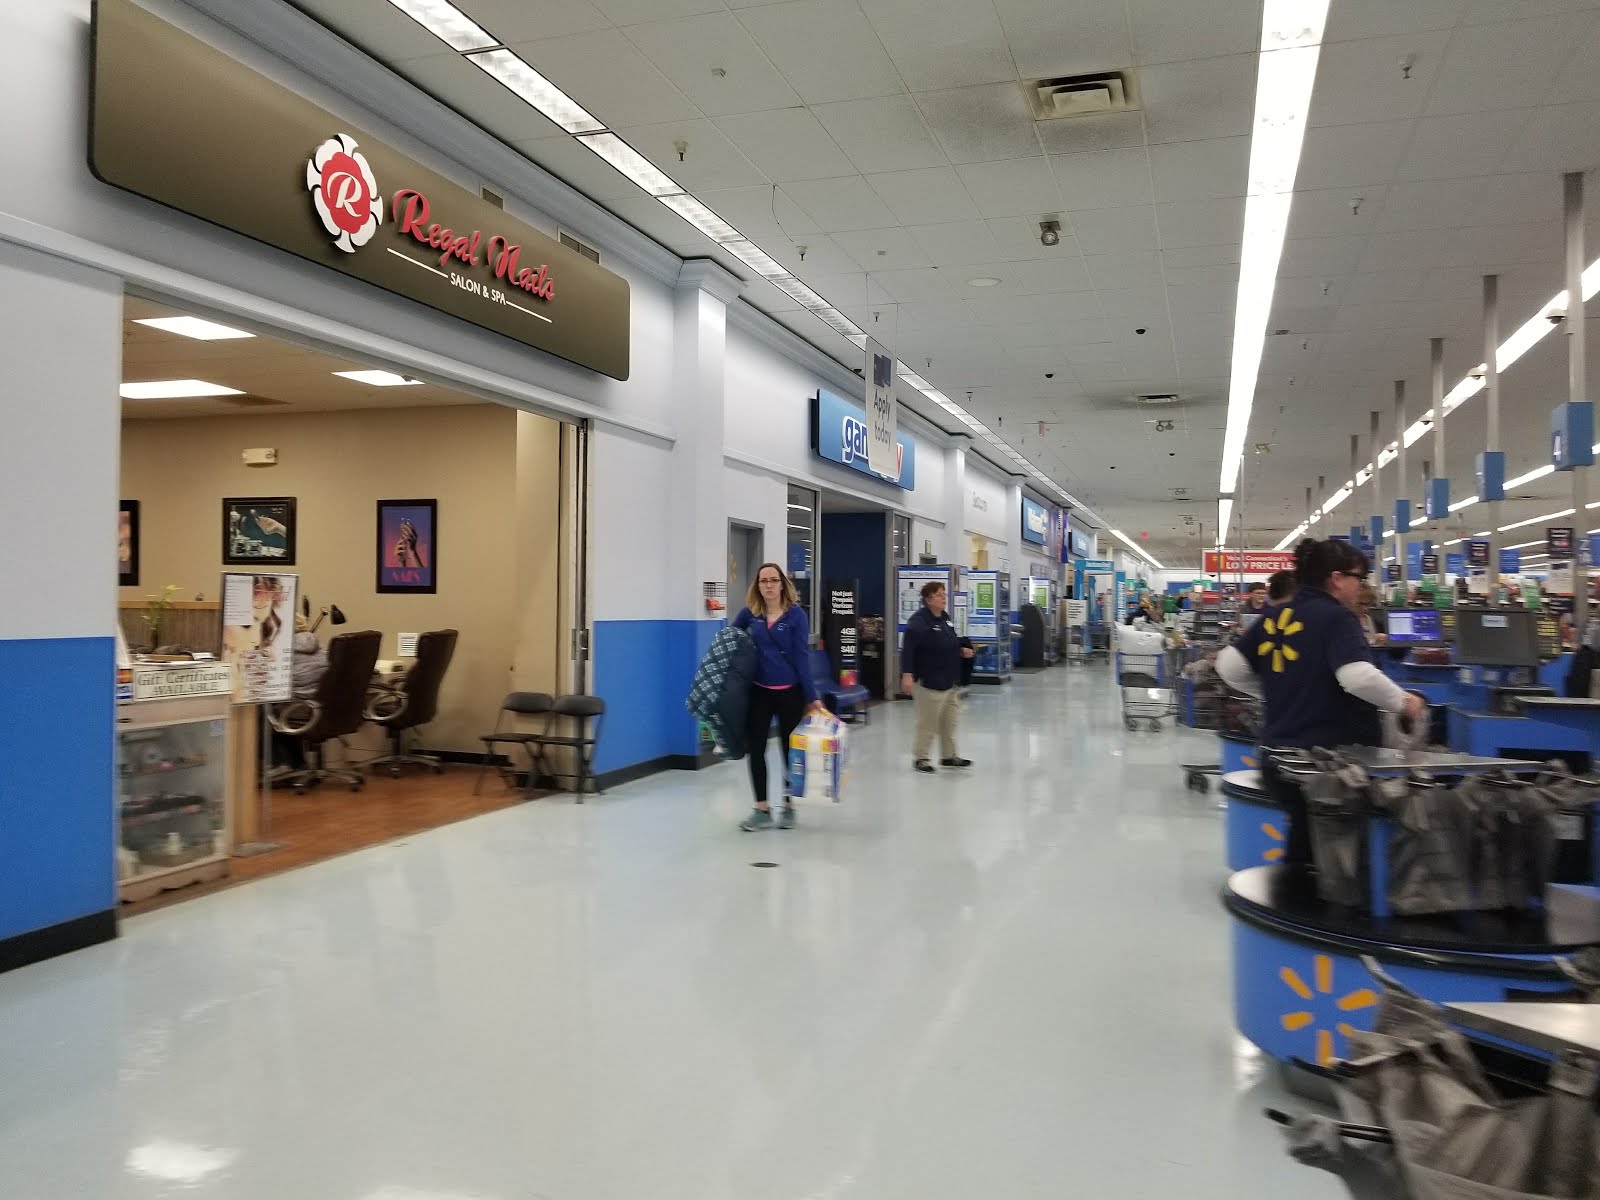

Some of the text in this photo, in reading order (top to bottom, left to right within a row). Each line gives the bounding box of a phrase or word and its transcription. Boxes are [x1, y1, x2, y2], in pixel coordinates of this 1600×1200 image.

[326, 171, 362, 218] R
[392, 189, 555, 300] Regal Nails
[450, 272, 507, 306] SALON & SPA
[873, 388, 891, 422] Apply
[874, 420, 891, 452] today
[1225, 561, 1249, 569] LOW
[1251, 561, 1281, 569] PRICE
[138, 670, 230, 686] Gift Certificates
[152, 682, 218, 696] AVAILABLE
